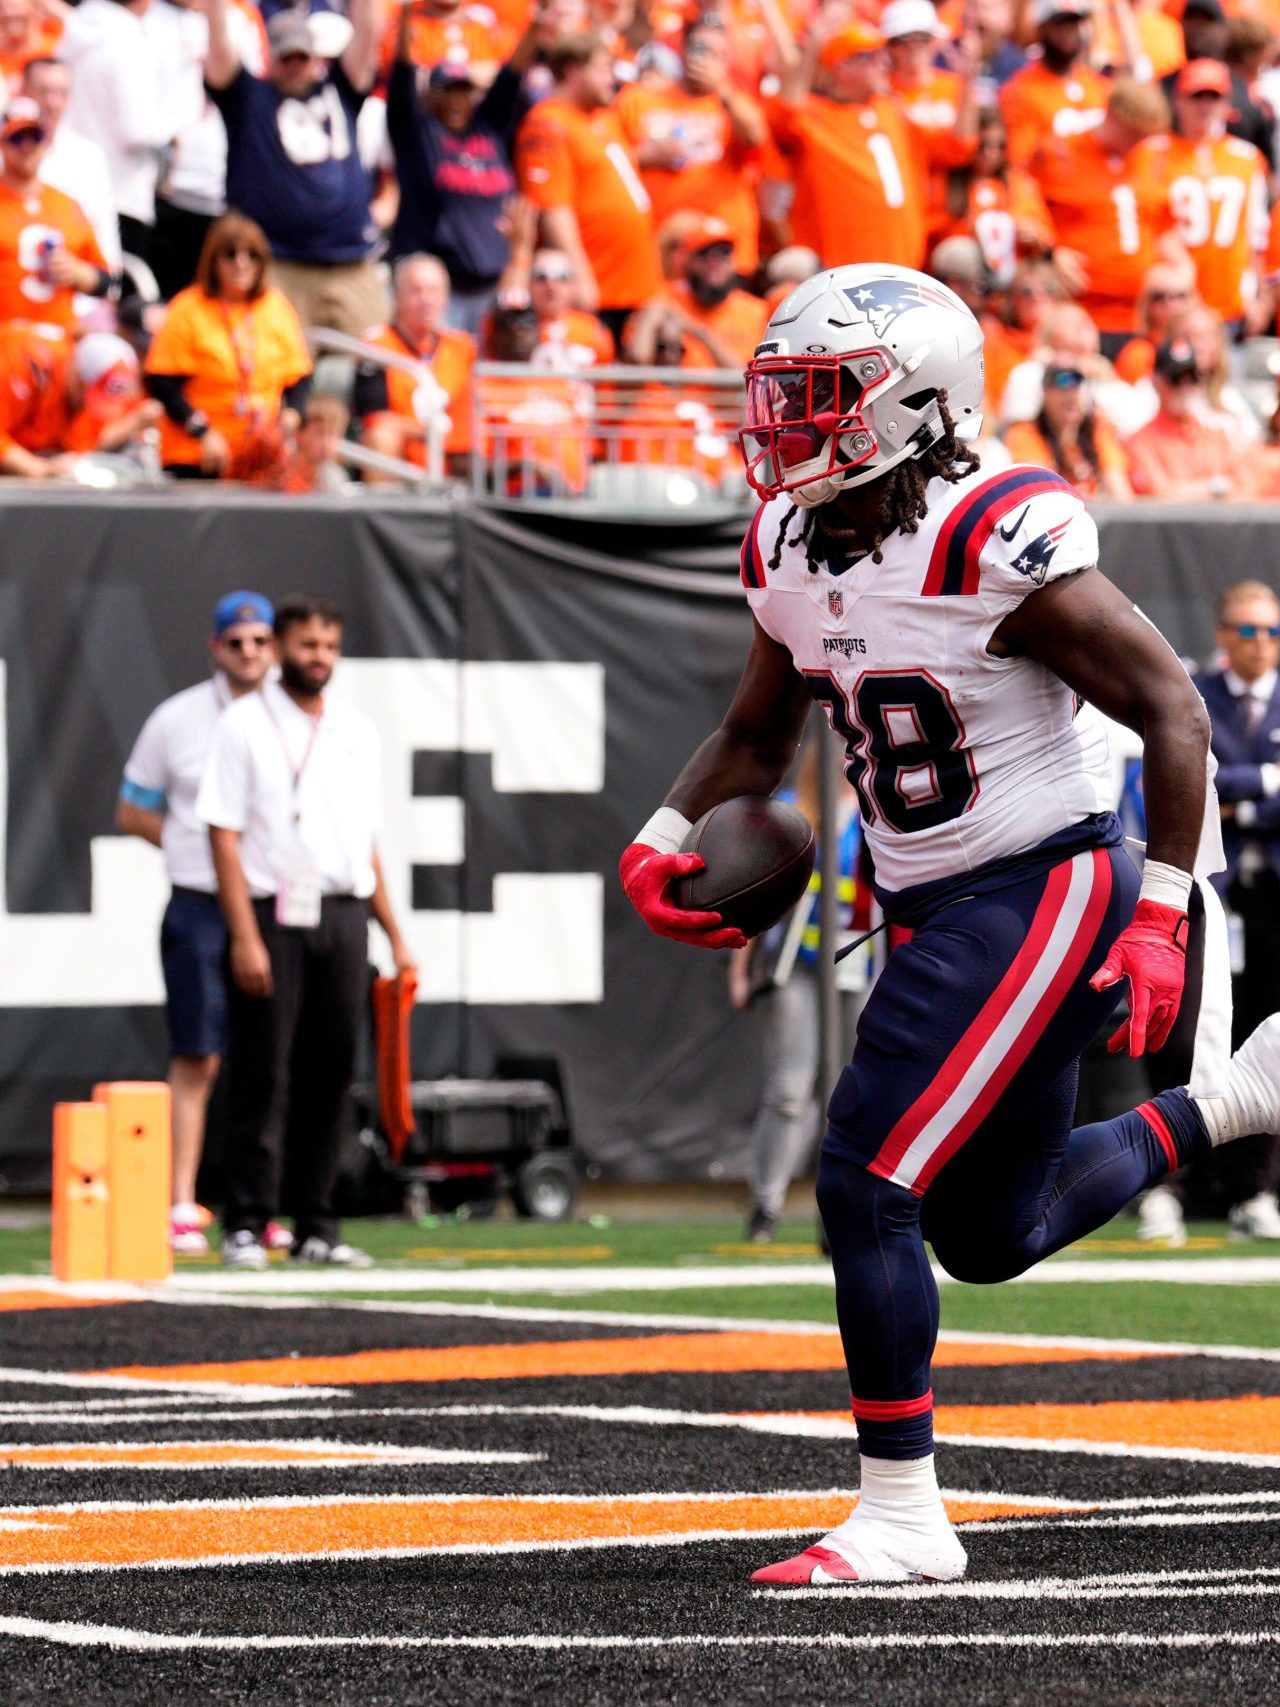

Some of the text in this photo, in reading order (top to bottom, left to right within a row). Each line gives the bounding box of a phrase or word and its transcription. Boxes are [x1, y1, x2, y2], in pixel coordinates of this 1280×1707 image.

[605, 141, 652, 213] 1
[866, 132, 905, 209] 1
[1111, 184, 1140, 255] 1
[1168, 175, 1246, 248] 97
[822, 638, 867, 655] PATRIOTS
